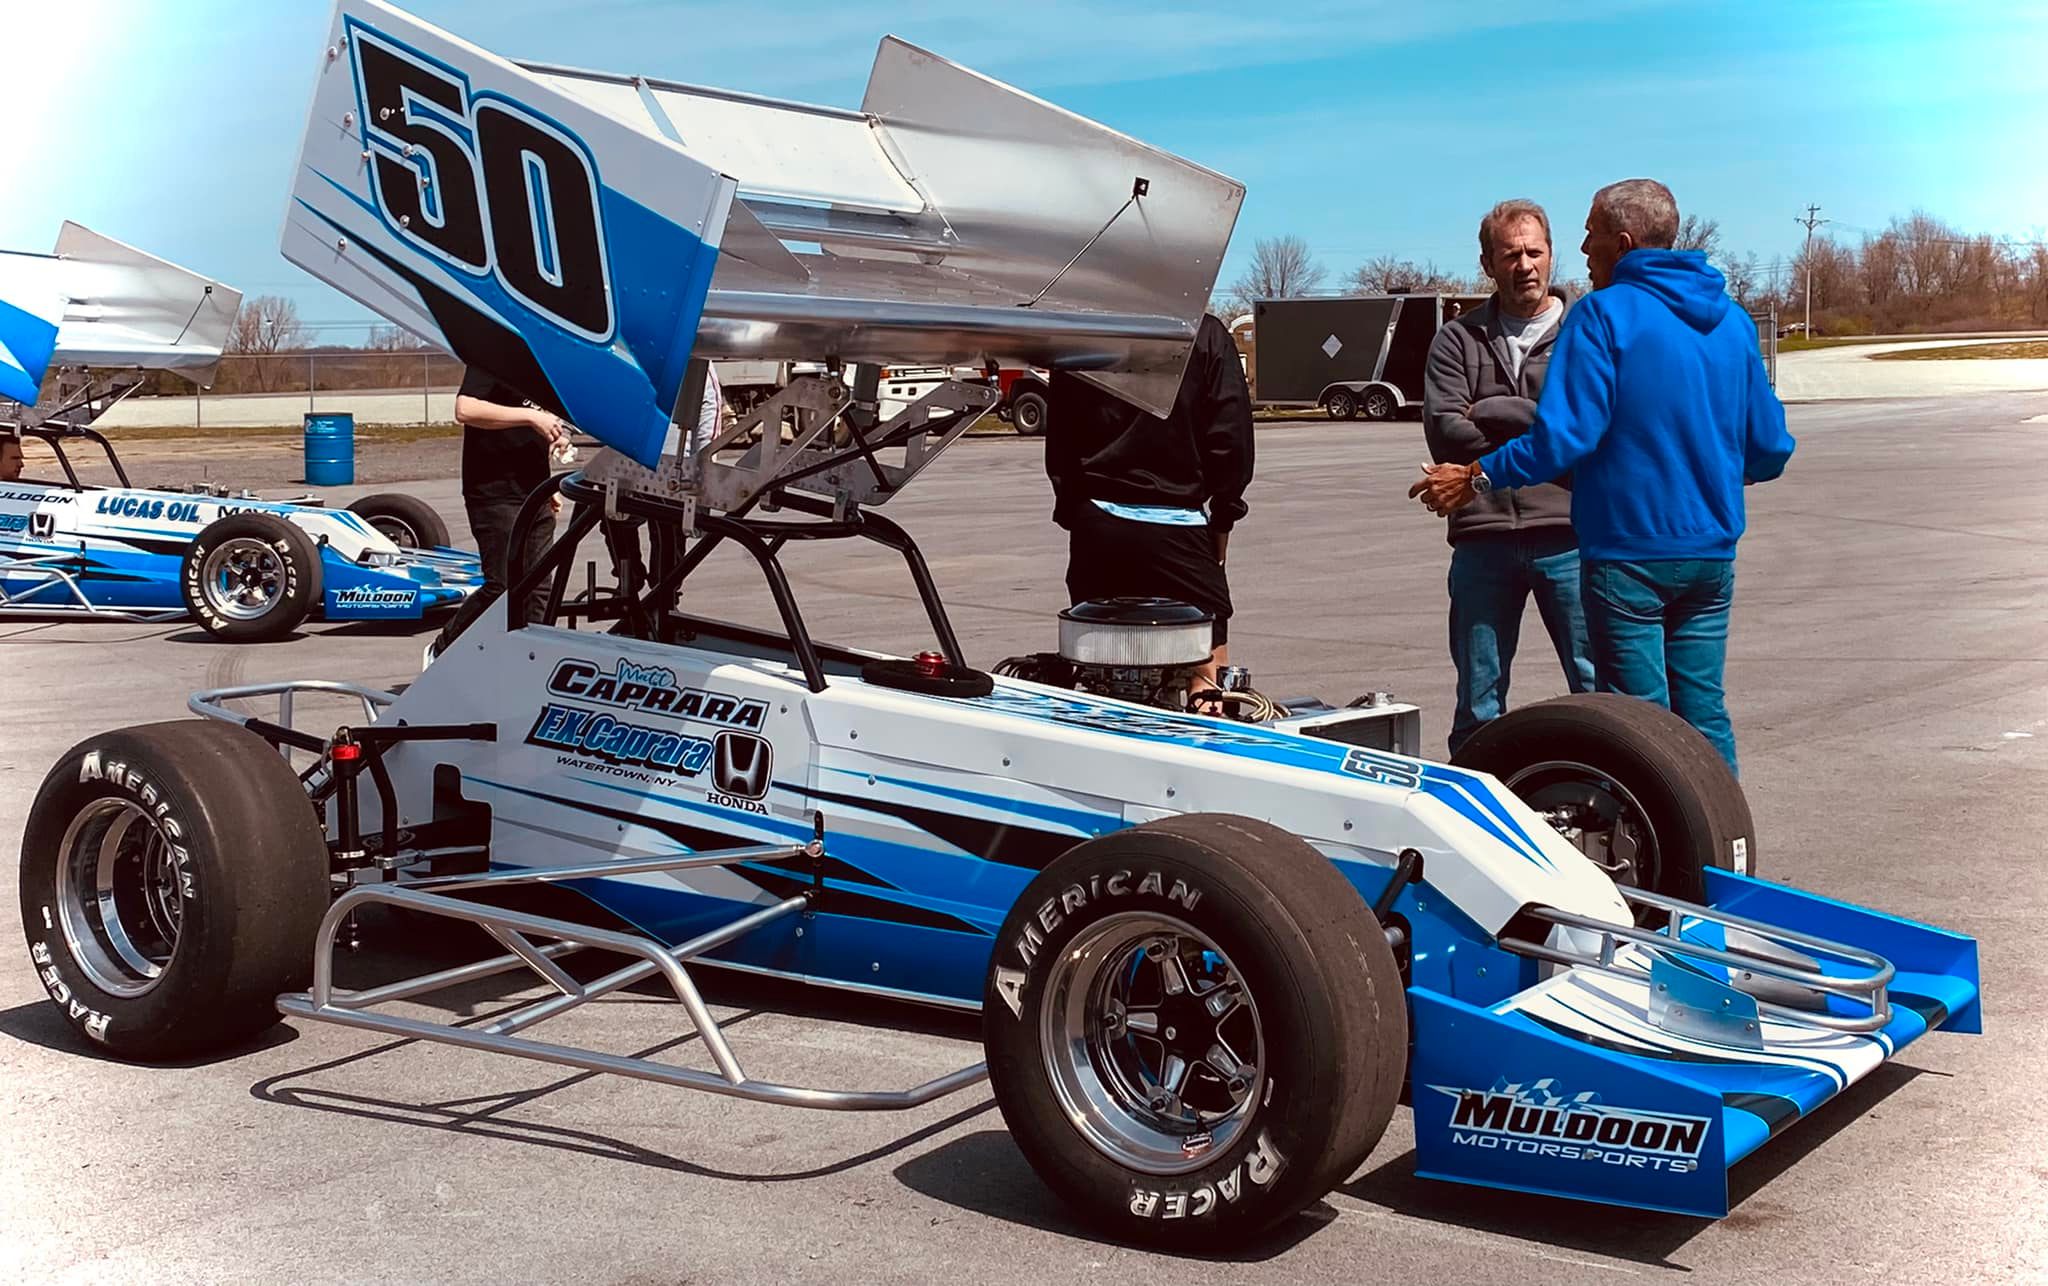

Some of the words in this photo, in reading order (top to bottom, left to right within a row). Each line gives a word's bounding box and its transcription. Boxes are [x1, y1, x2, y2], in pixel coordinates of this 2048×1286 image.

[349, 22, 617, 343] 50
[0, 490, 73, 504] ULDOON
[96, 496, 164, 519] LUCAS
[167, 502, 200, 523] OIL
[188, 544, 229, 630] AMERICAN
[274, 538, 297, 598] RACER
[337, 590, 417, 603] MULDOON
[548, 659, 768, 732] CAPRARA
[618, 659, 675, 687] Matt
[557, 756, 653, 783] WATERTOWN,
[653, 777, 677, 787] NY
[584, 714, 713, 773] Caprara
[1341, 748, 1423, 790] 50
[79, 750, 196, 899] AMERICAN
[706, 792, 768, 815] HONDA
[995, 870, 1203, 1021] AMERICAN
[32, 941, 112, 1044] RACER
[1450, 1091, 1711, 1158] MULDOON
[1453, 1132, 1690, 1173] MOTORSPORTS
[1129, 1134, 1289, 1220] RACER
